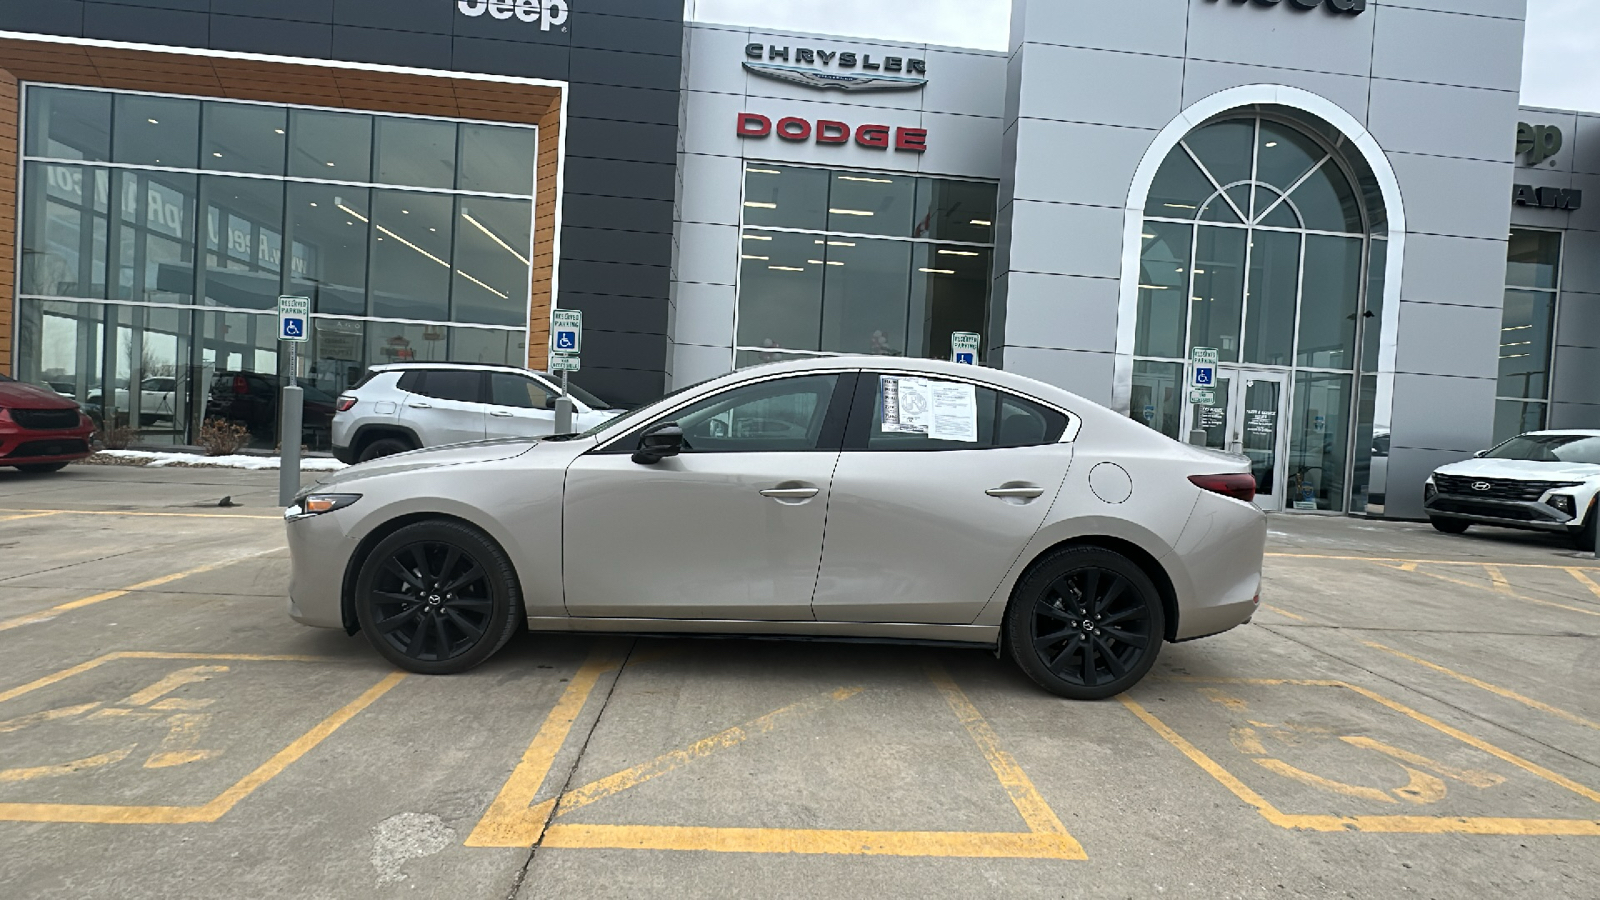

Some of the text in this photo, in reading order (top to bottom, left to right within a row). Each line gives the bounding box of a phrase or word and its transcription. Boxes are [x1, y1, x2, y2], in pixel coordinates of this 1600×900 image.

[745, 43, 926, 73] CHRYSLER
[737, 112, 927, 153] DODGE
[1512, 183, 1582, 210] AM
[281, 299, 307, 308] RESERVED
[281, 307, 307, 315] PARKING
[555, 312, 579, 321] RESERVED
[554, 320, 579, 328] PARKING
[954, 342, 977, 350] PARKING
